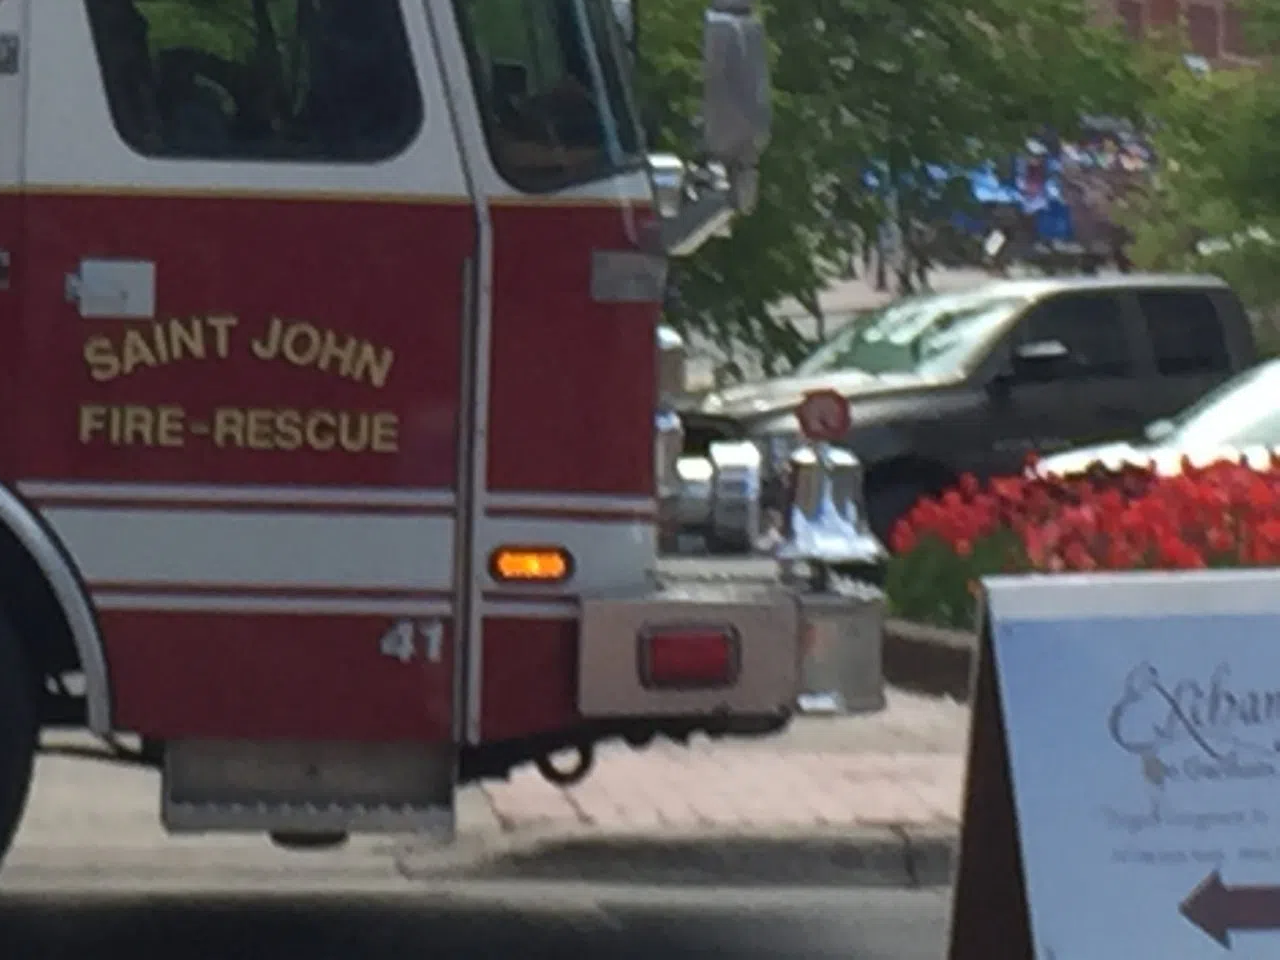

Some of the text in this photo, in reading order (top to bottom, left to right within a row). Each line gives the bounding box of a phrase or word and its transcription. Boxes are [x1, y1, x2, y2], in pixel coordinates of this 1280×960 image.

[83, 315, 395, 388] SAINT JOHN
[78, 404, 400, 453] FIRE-RESCUE
[380, 620, 443, 663] 41
